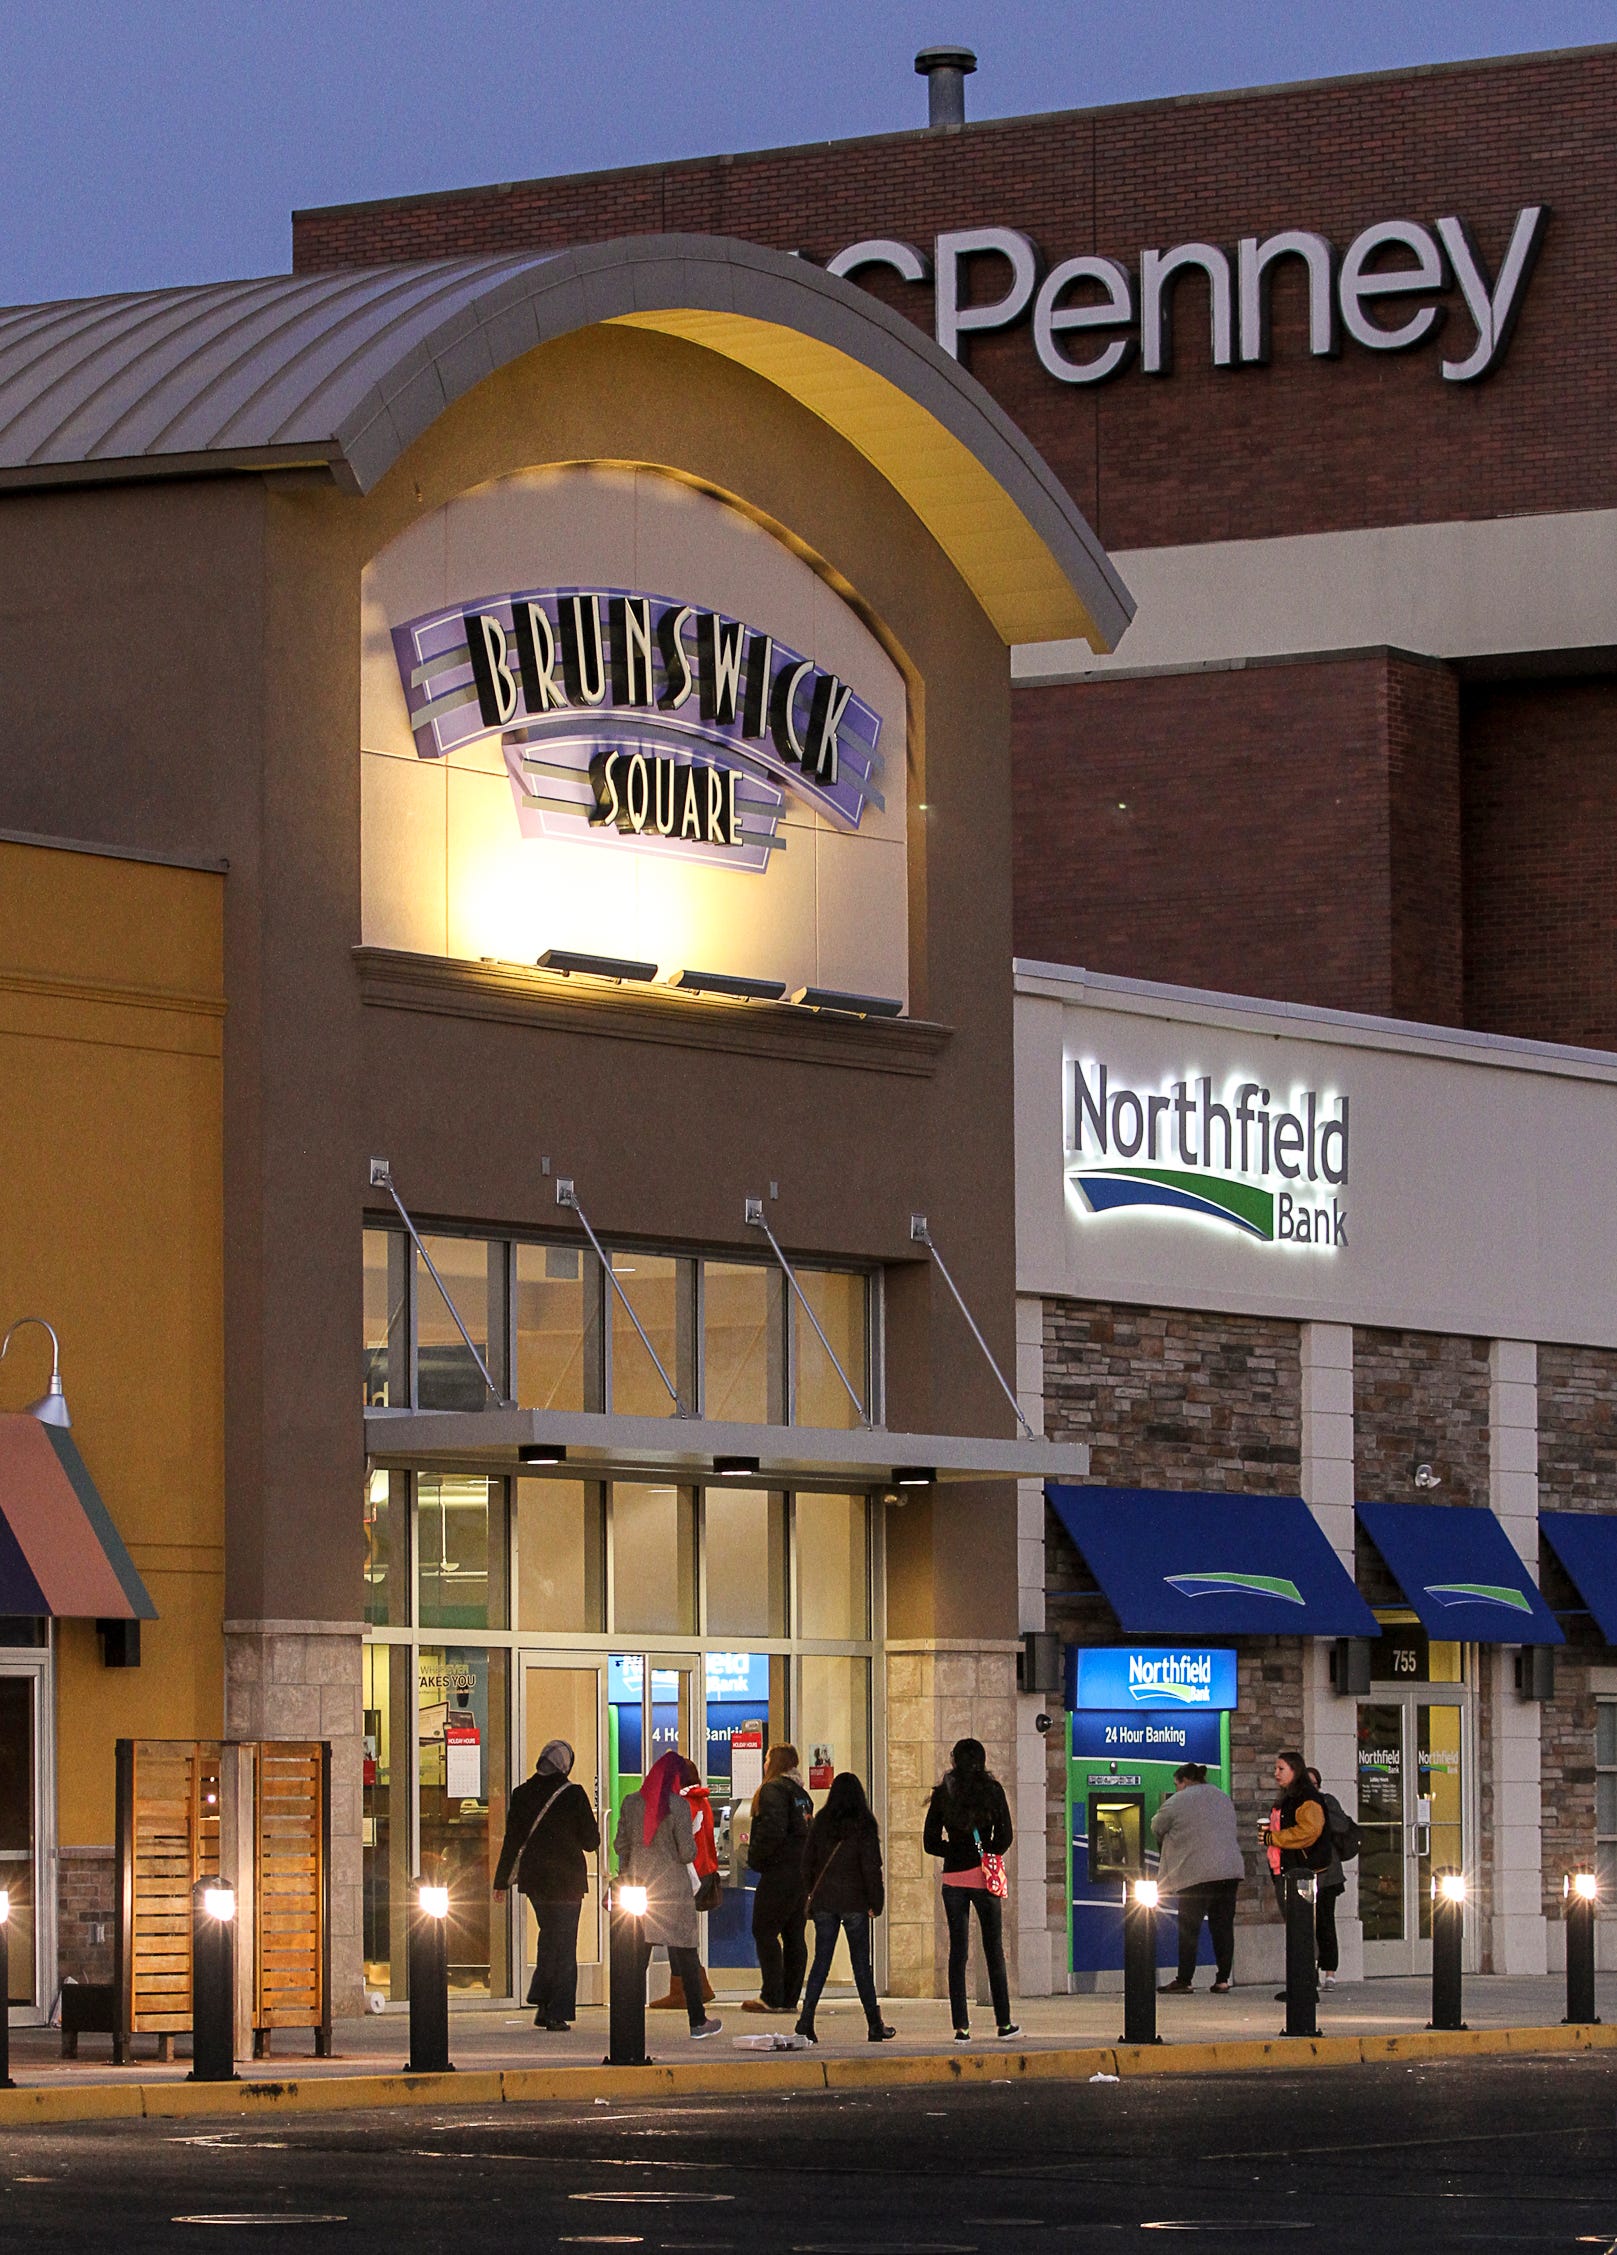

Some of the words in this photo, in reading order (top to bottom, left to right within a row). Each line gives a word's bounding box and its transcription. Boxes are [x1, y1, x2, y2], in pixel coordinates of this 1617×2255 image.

[787, 206, 1543, 382] Penney
[465, 595, 853, 785] BRUNSWICK
[592, 750, 744, 846] SQUARE
[1066, 1060, 1349, 1185] Northfield
[1278, 1192, 1348, 1247] Bank
[1129, 1654, 1211, 1684] Northfield
[1393, 1650, 1416, 1672] 755
[419, 1675, 450, 1688] AKES
[452, 1675, 476, 1688] YOU
[1190, 1685, 1210, 1702] Bank
[1105, 1726, 1118, 1743] 24
[1120, 1726, 1144, 1743] Hour
[1146, 1726, 1186, 1747] Banking
[1359, 1750, 1400, 1765] Northfield
[1418, 1750, 1459, 1765] Northfield
